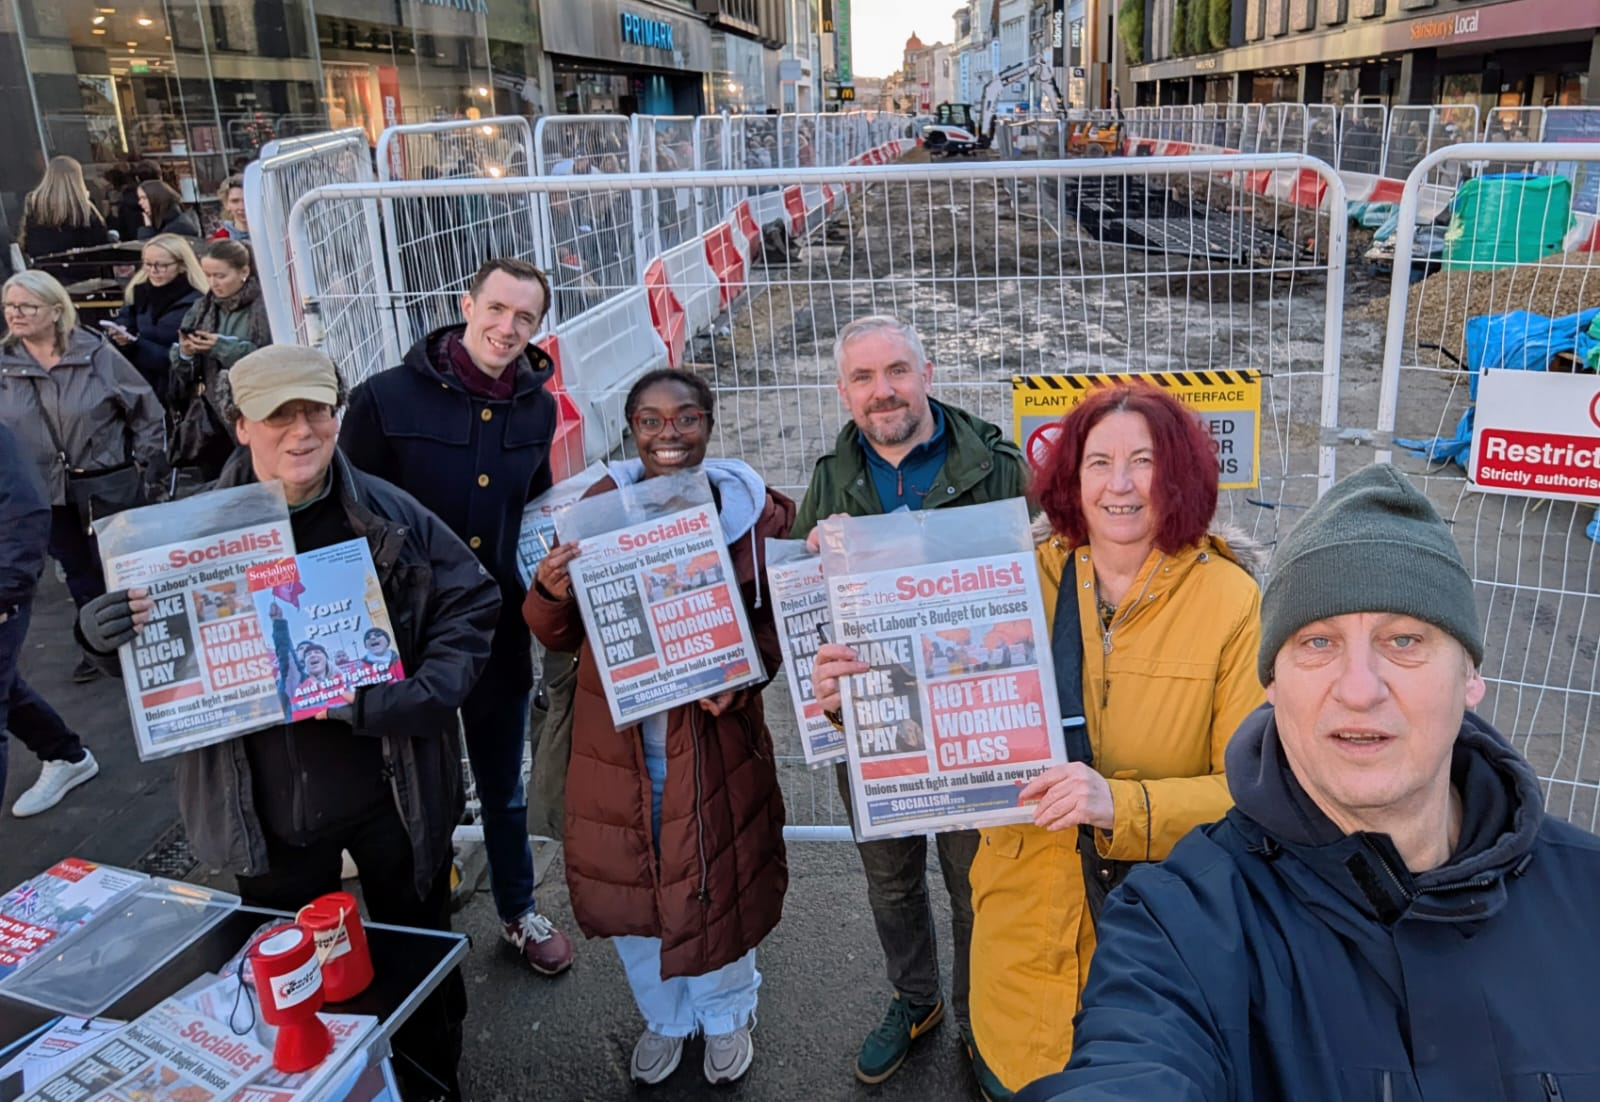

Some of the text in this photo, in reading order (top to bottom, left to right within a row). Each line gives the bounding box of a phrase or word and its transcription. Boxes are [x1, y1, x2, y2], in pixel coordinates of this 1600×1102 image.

[622, 12, 673, 50] PRIMARK
[1410, 10, 1479, 40] Sainsbury's Local
[1024, 395, 1079, 407] PLANT &
[1172, 391, 1245, 402] INTERFACE
[1209, 419, 1235, 434] ED
[1486, 437, 1600, 468] Restrict
[1481, 466, 1531, 485] Strictly
[618, 512, 710, 551] Socialist
[169, 528, 282, 568] Socialist
[582, 538, 714, 584] Reject Labour's Budget for bosses
[155, 574, 197, 594] Labour's
[200, 566, 233, 583] Budget
[249, 563, 297, 580] Socialism
[874, 590, 897, 606] the
[895, 561, 1025, 601] Socialist
[590, 578, 637, 606] MAKE
[780, 596, 808, 612] Reject
[808, 592, 827, 605] Labo
[151, 595, 184, 621] AKE
[304, 599, 352, 620] Your
[595, 602, 627, 624] THE
[654, 591, 716, 623] NOT THE
[843, 600, 1028, 639] Reject Labour's Budget for bosses
[136, 621, 170, 646] THE
[204, 621, 241, 646] NOT
[600, 618, 642, 645] RICH
[659, 606, 734, 643] WORKING
[136, 638, 186, 667] RICH
[208, 636, 267, 666] WORK
[606, 640, 635, 664] PAY
[665, 633, 714, 662] CLASS
[850, 638, 911, 667] MAKE
[140, 662, 176, 689] PAY
[212, 657, 273, 688] CLASS
[295, 662, 391, 698] And the fight for
[613, 682, 638, 695] Unions
[639, 675, 657, 687] must
[658, 669, 674, 682] fight
[676, 664, 688, 675] and
[690, 657, 706, 670] build
[712, 652, 727, 662] new
[727, 647, 745, 661] party
[852, 669, 894, 697] THE
[145, 708, 176, 722] Unions
[178, 701, 200, 713] must
[202, 696, 223, 709] fight
[223, 691, 238, 701] and
[240, 685, 260, 697] build
[635, 682, 678, 703] SOCIALISM
[933, 676, 1020, 710] NOT THE
[170, 709, 224, 731] SOCIALISM
[855, 695, 911, 726] RICH
[934, 702, 1042, 739] WORKING
[859, 726, 898, 754] PAY
[939, 735, 1010, 768] CLASS
[864, 783, 898, 796] Unions
[899, 779, 924, 792] must
[926, 777, 949, 792] fight
[951, 774, 968, 787] and
[970, 771, 995, 784] build
[997, 771, 1003, 781] a
[1005, 768, 1024, 780] new
[890, 794, 950, 812] SOCIALISM
[6, 936, 37, 949] right
[22, 926, 50, 940] fight
[95, 1040, 148, 1074] MAKE
[125, 1025, 153, 1044] Reject
[144, 1036, 177, 1058] Labour's
[169, 1050, 200, 1071] Budget
[201, 1068, 230, 1090] bosses
[180, 1020, 263, 1072] Socialist
[70, 1058, 110, 1085] THE
[42, 1076, 91, 1102] RICH
